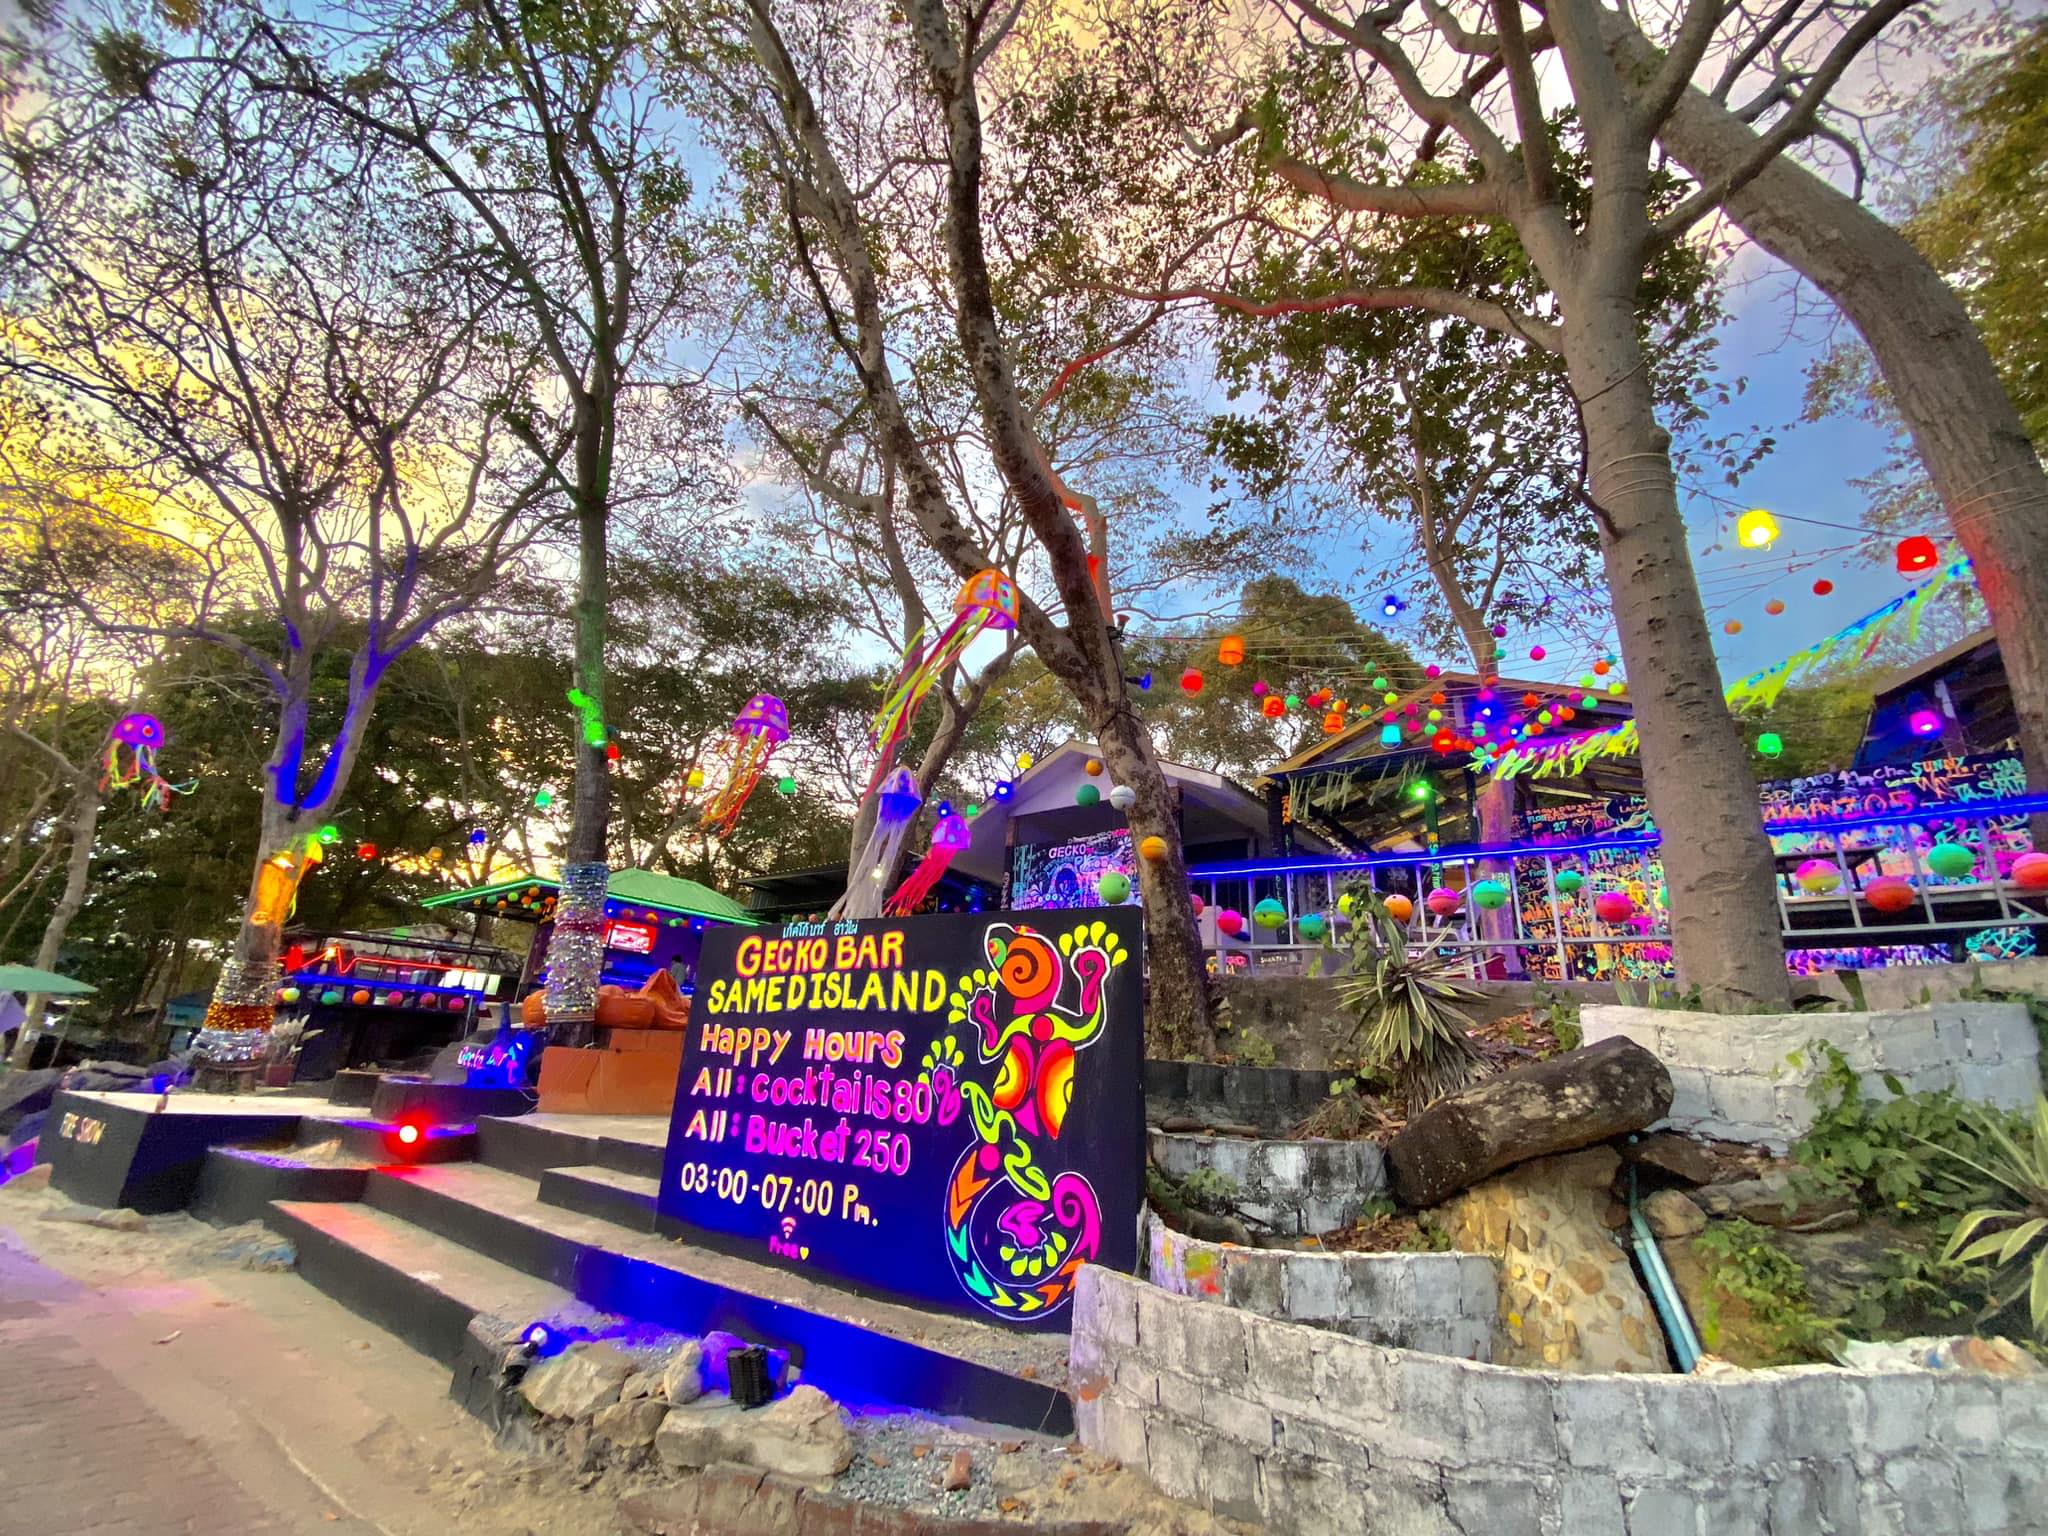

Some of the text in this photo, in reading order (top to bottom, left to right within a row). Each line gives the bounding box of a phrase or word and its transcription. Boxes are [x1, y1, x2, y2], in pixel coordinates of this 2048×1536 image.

[735, 930, 905, 979] GECKO BAR
[700, 1023, 906, 1069] Happy Hours
